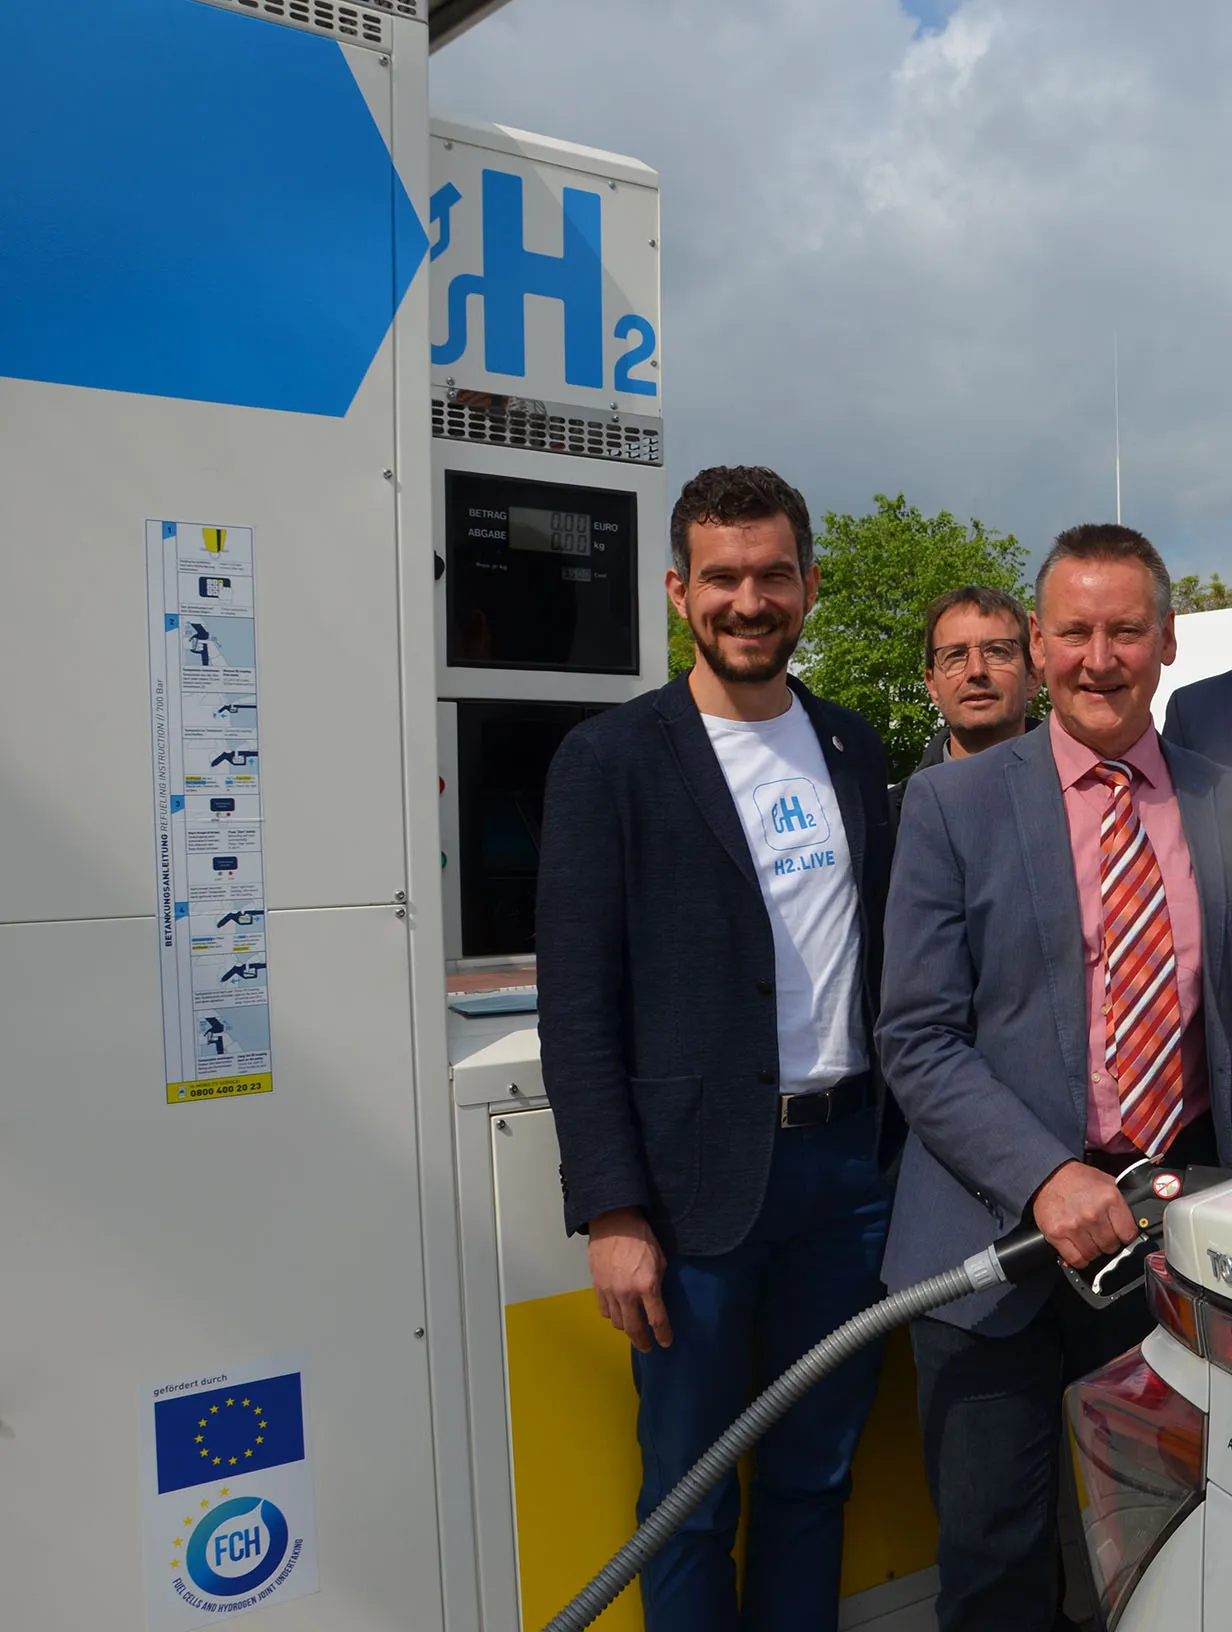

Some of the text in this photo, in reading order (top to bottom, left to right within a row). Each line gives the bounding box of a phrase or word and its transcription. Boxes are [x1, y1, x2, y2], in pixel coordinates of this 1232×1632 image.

[468, 508, 507, 520] BETRAG
[468, 528, 507, 540] ABGABE
[593, 521, 619, 532] EURO
[593, 541, 605, 551] kg
[156, 680, 164, 695] Bar
[156, 697, 164, 711] 700
[157, 722, 167, 780] INSTRUCTION
[159, 783, 168, 832] REFUELING
[774, 850, 836, 876] H2.LIVE
[160, 833, 173, 947] BETANKUNGSANLEITUNG
[190, 1087, 214, 1097] 0800
[216, 1085, 234, 1094] 400
[236, 1084, 248, 1092] 20
[250, 1082, 262, 1090] 23
[153, 1374, 228, 1398] gefördert durch
[214, 1525, 262, 1567] FCH
[172, 1538, 304, 1613] FUEL CELLS AND HYDROGEN JOINT UNDERTAKING
